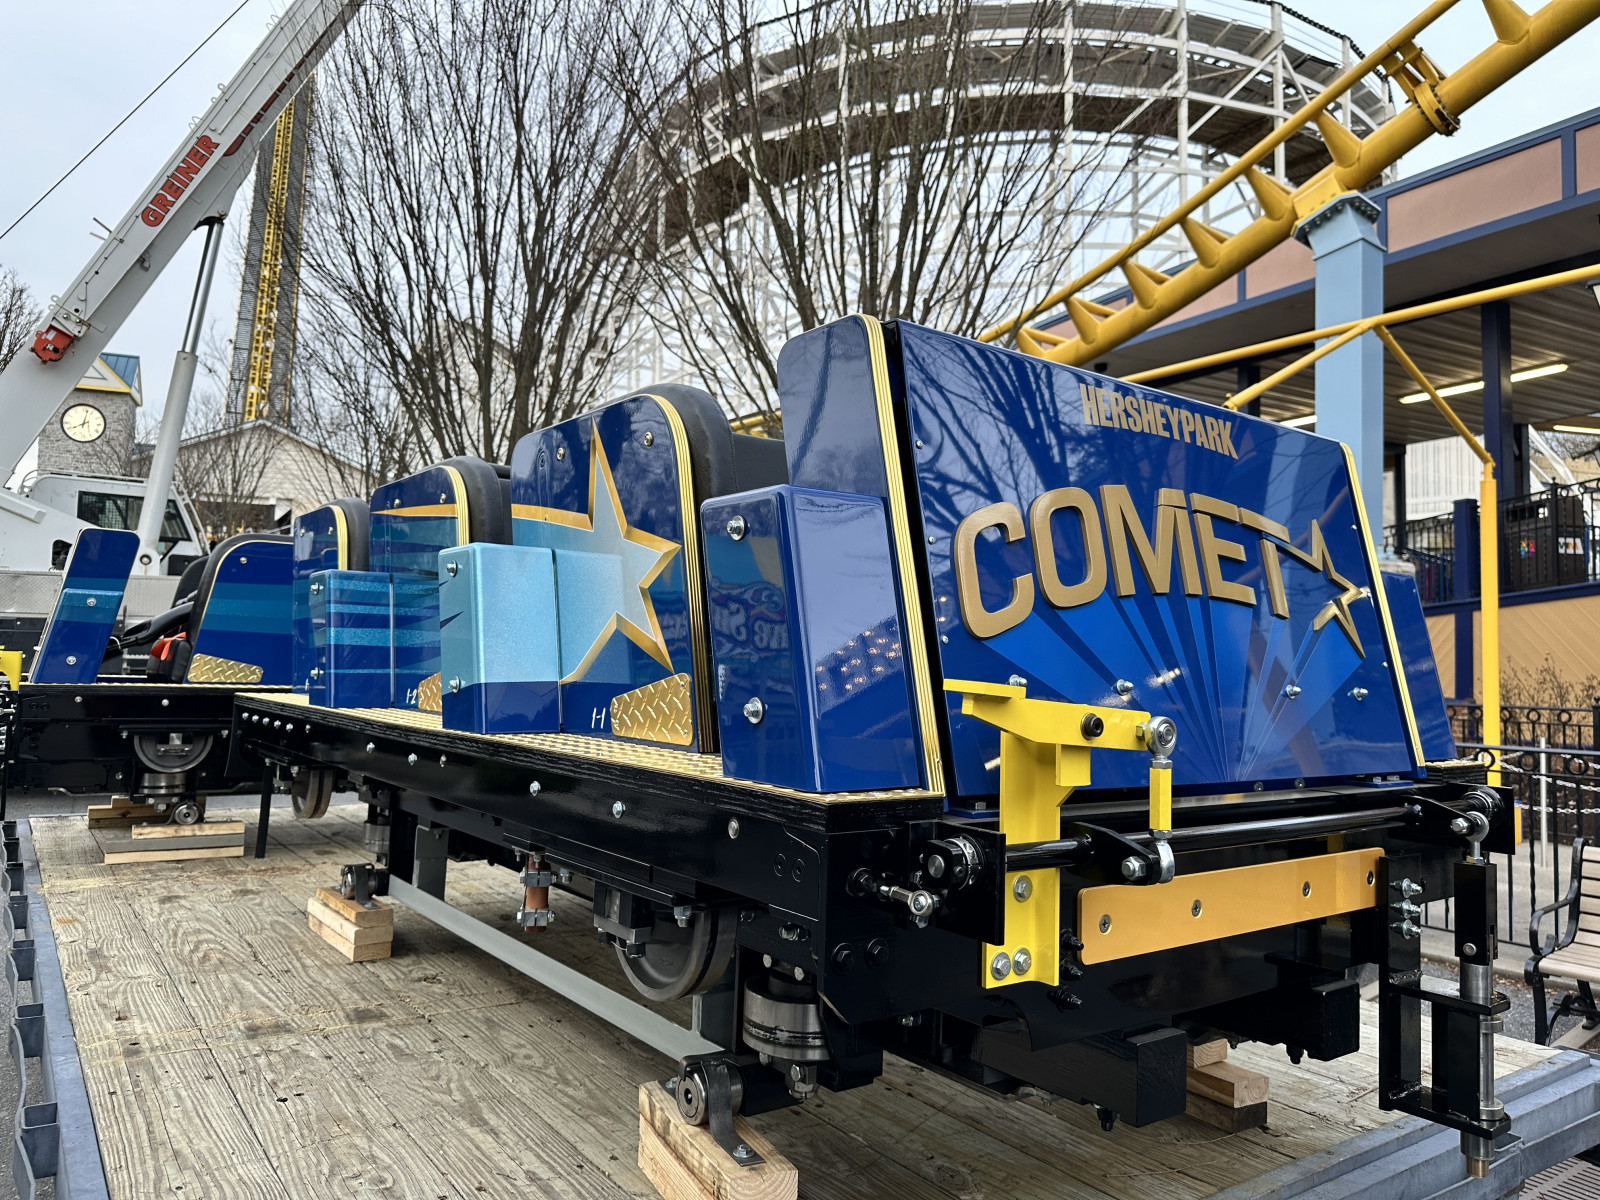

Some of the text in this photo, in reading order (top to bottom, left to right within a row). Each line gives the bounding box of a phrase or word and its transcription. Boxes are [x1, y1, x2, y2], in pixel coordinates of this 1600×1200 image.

[141, 134, 220, 227] GREINER
[1079, 382, 1239, 460] HERSHEYPARK
[953, 484, 1291, 639] COMET
